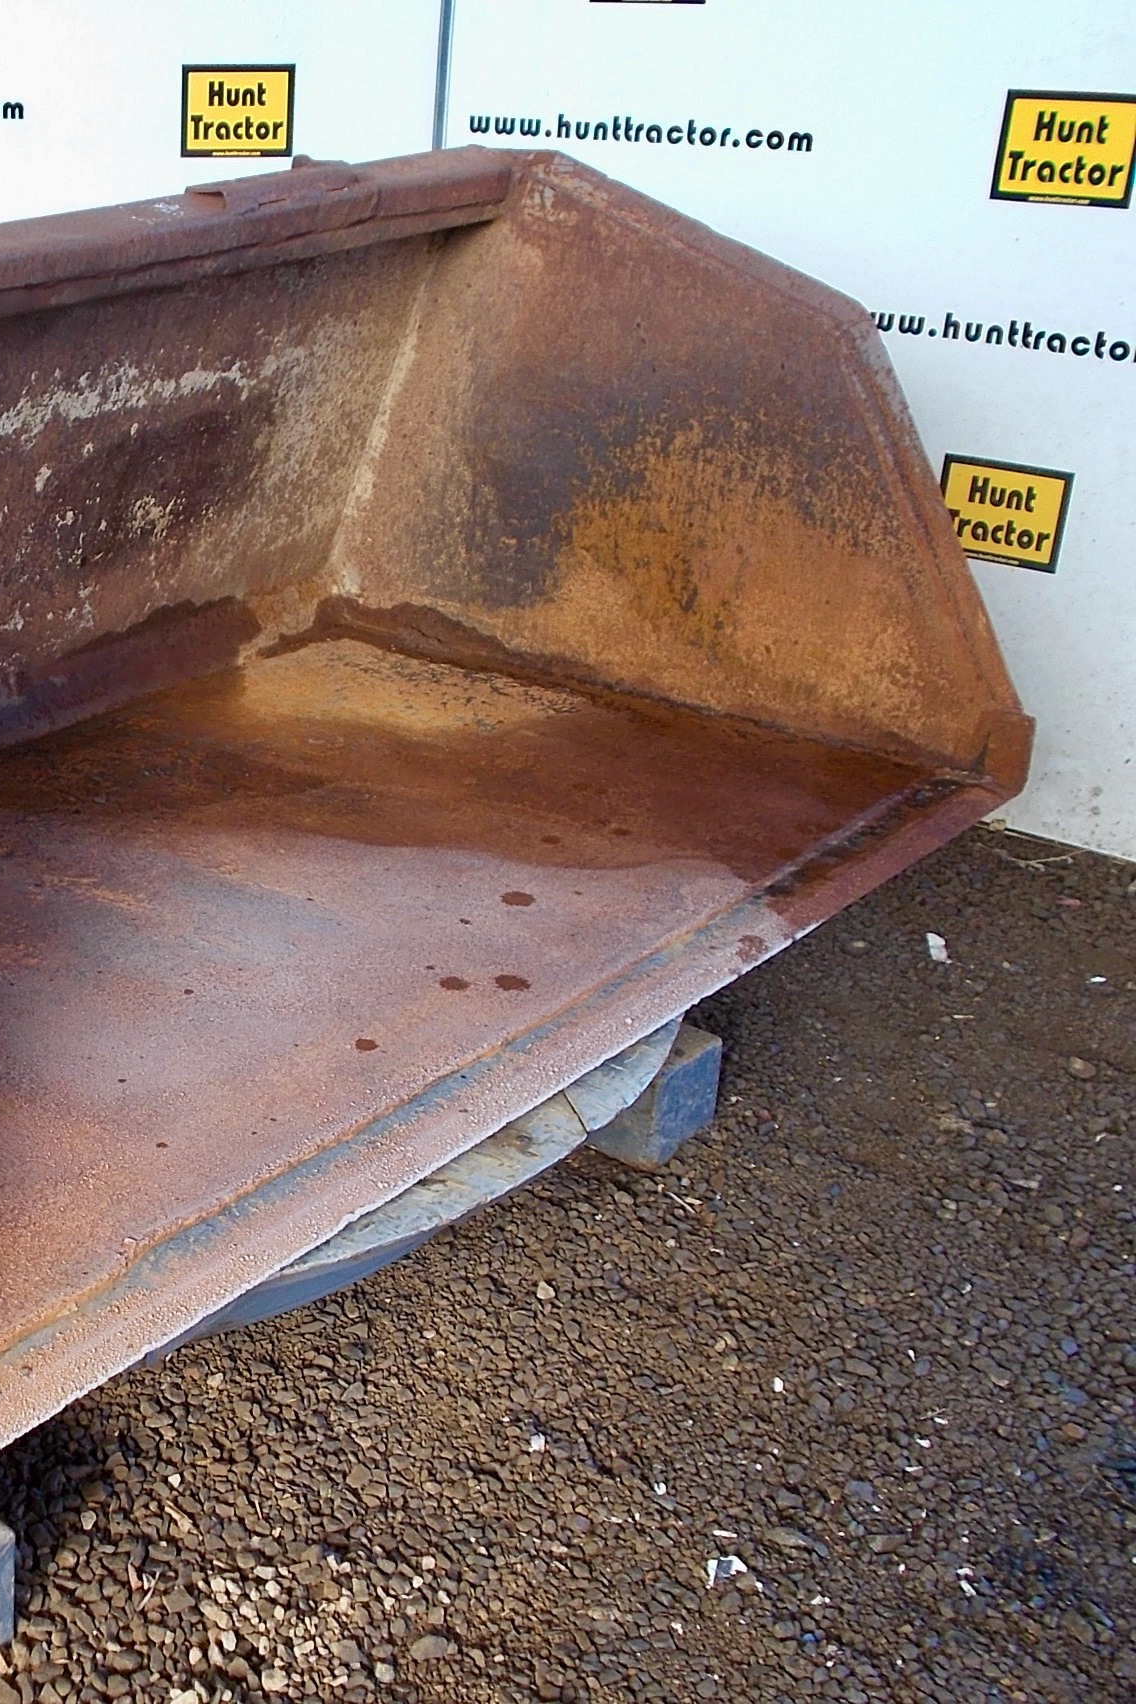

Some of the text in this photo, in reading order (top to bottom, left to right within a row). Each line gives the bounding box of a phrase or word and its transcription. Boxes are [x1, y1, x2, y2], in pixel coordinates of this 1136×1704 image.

[208, 81, 266, 106] Hunt
[191, 115, 283, 140] Tractor
[469, 113, 813, 152] www.hunttractor.com
[1033, 111, 1109, 144] Hunt
[1008, 150, 1123, 186] Tractor
[968, 475, 1037, 512] Hunt
